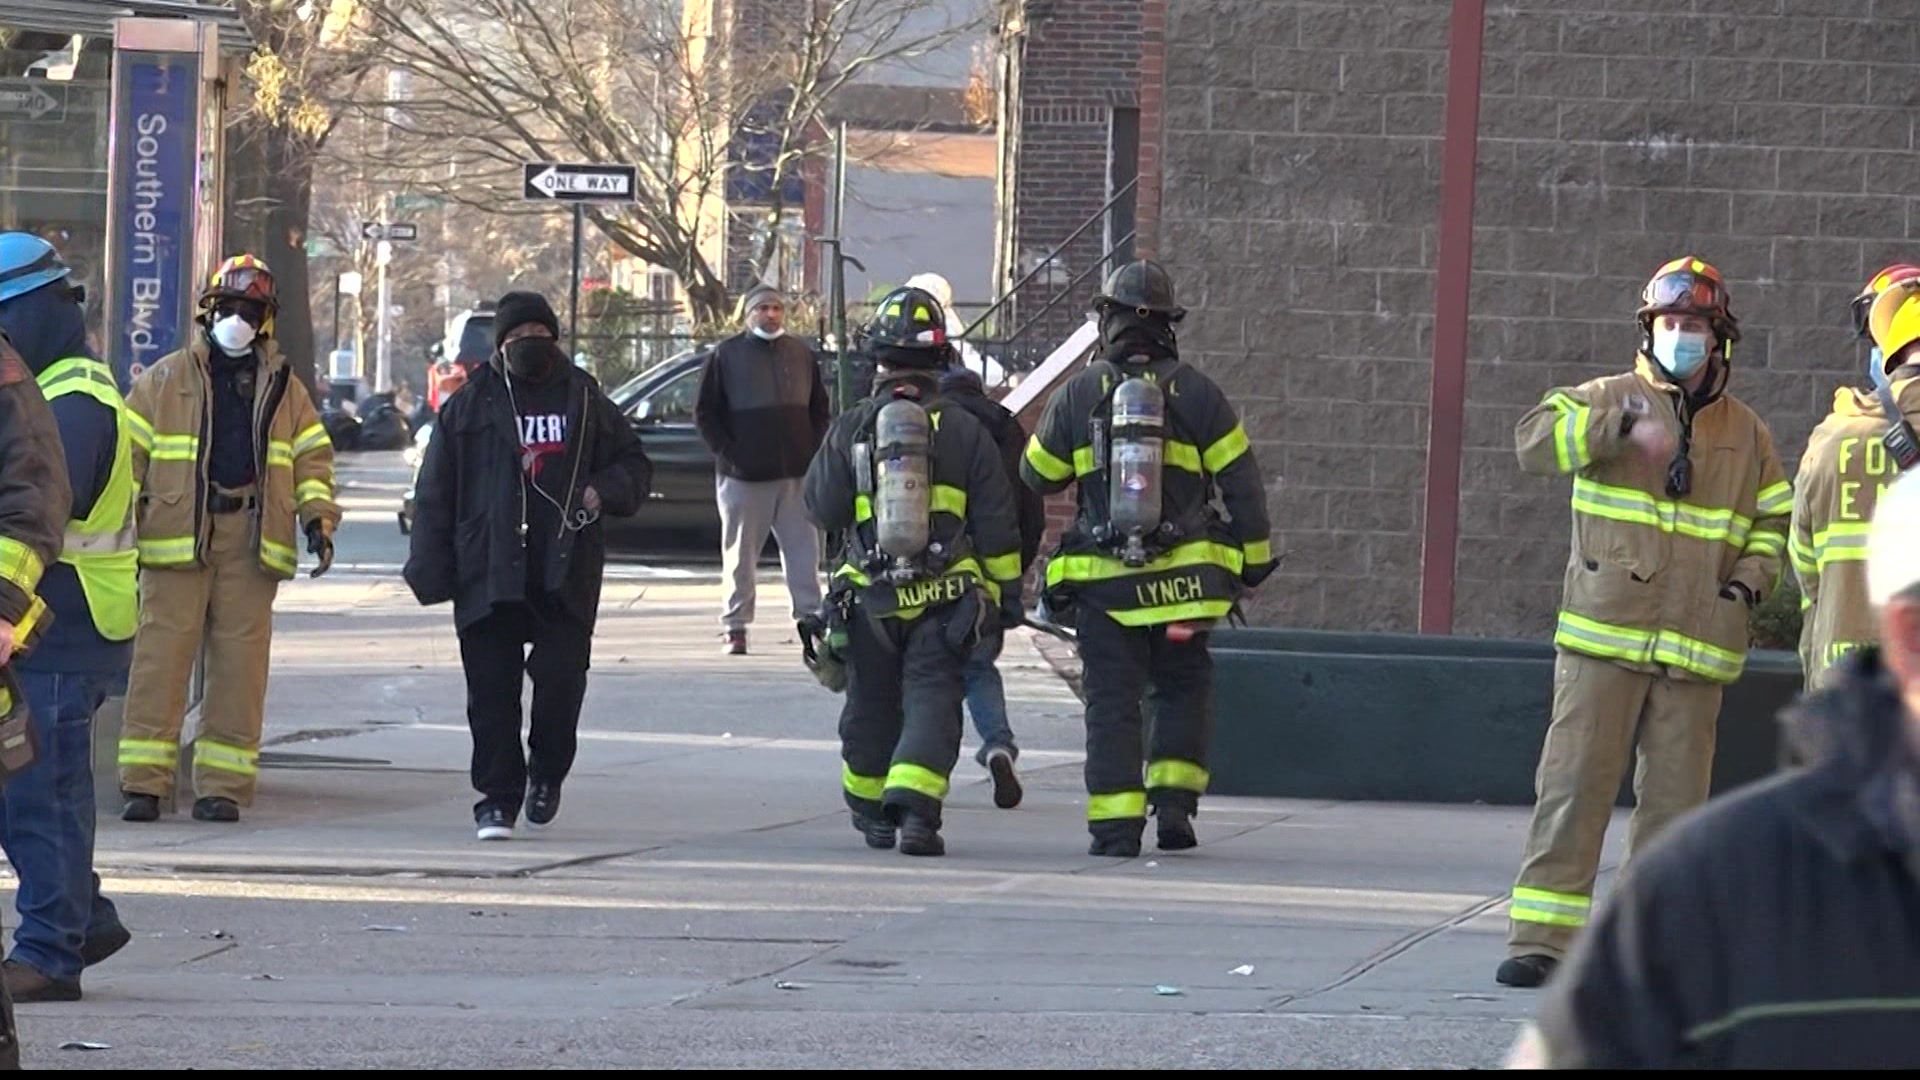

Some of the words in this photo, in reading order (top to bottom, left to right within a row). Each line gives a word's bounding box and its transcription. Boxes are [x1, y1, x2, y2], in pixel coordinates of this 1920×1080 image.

[133, 113, 167, 264] Southern
[544, 174, 575, 190] ONE
[586, 178, 620, 190] WAY
[130, 277, 161, 351] Blvd
[1135, 575, 1203, 606] LYNCH
